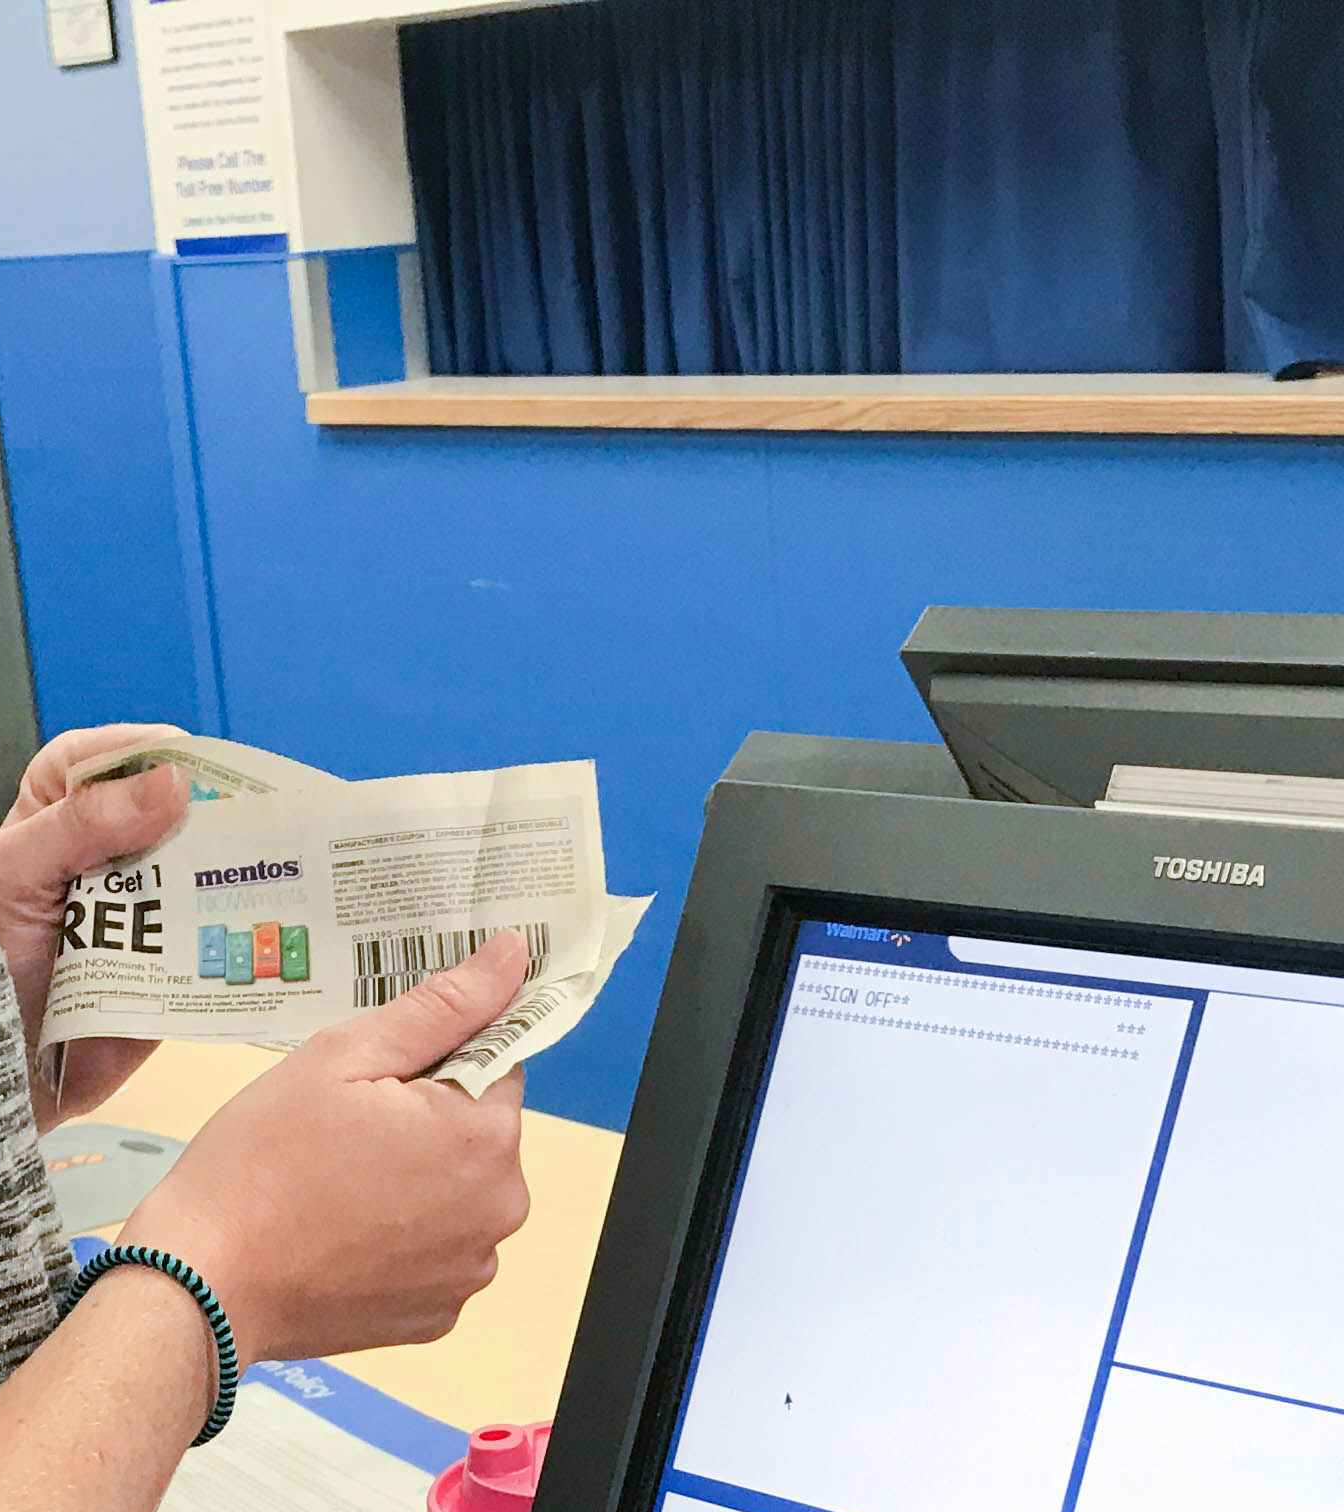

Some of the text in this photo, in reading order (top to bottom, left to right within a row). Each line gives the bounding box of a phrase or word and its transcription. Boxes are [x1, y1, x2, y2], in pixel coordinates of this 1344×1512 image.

[104, 871, 143, 894] Get
[152, 864, 162, 888] 1
[195, 859, 302, 888] mentos
[1153, 855, 1266, 887] TOSHIBA
[57, 898, 163, 957] REE
[84, 971, 144, 983] NOWmints
[168, 975, 192, 985] FREE
[85, 958, 145, 972] NOWmints
[284, 1365, 337, 1398] Policy
